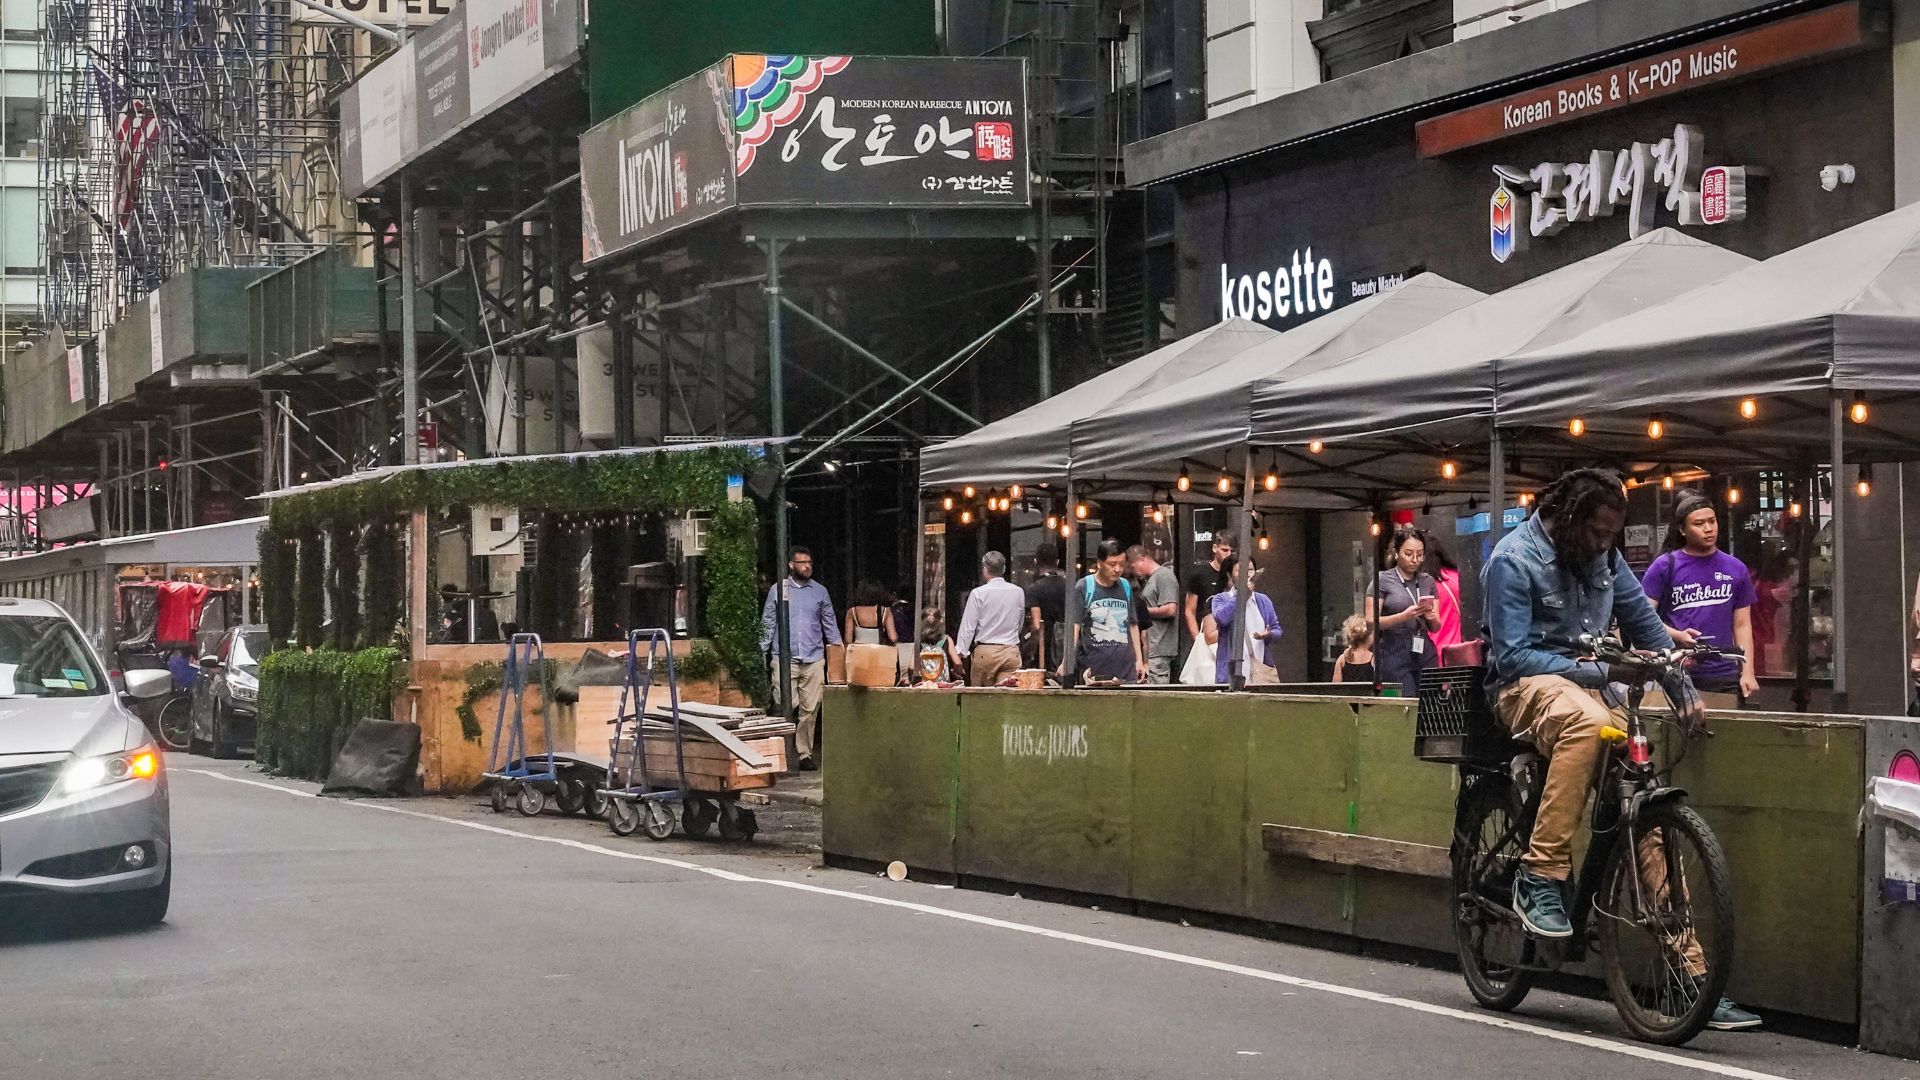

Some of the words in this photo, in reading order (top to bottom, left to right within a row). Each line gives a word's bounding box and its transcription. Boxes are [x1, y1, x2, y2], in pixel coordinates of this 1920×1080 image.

[481, 20, 502, 60] Jongro
[503, 2, 525, 46] Market
[840, 99, 881, 109] MODERN
[882, 99, 918, 109] KOREAN
[919, 99, 963, 109] BARBECUE
[964, 101, 1013, 116] ANTOYA
[1504, 99, 1552, 130] Korean
[1558, 83, 1603, 115] Books
[1609, 74, 1621, 101] &
[1628, 57, 1682, 96] K-POP
[1689, 45, 1738, 80] Music
[618, 138, 675, 236] ANTOYA
[1221, 245, 1334, 321] kosette
[1351, 278, 1377, 298] Beauty
[1671, 583, 1733, 606] Kickball
[1002, 723, 1034, 757] TOUS
[1047, 723, 1089, 765] JOURS
